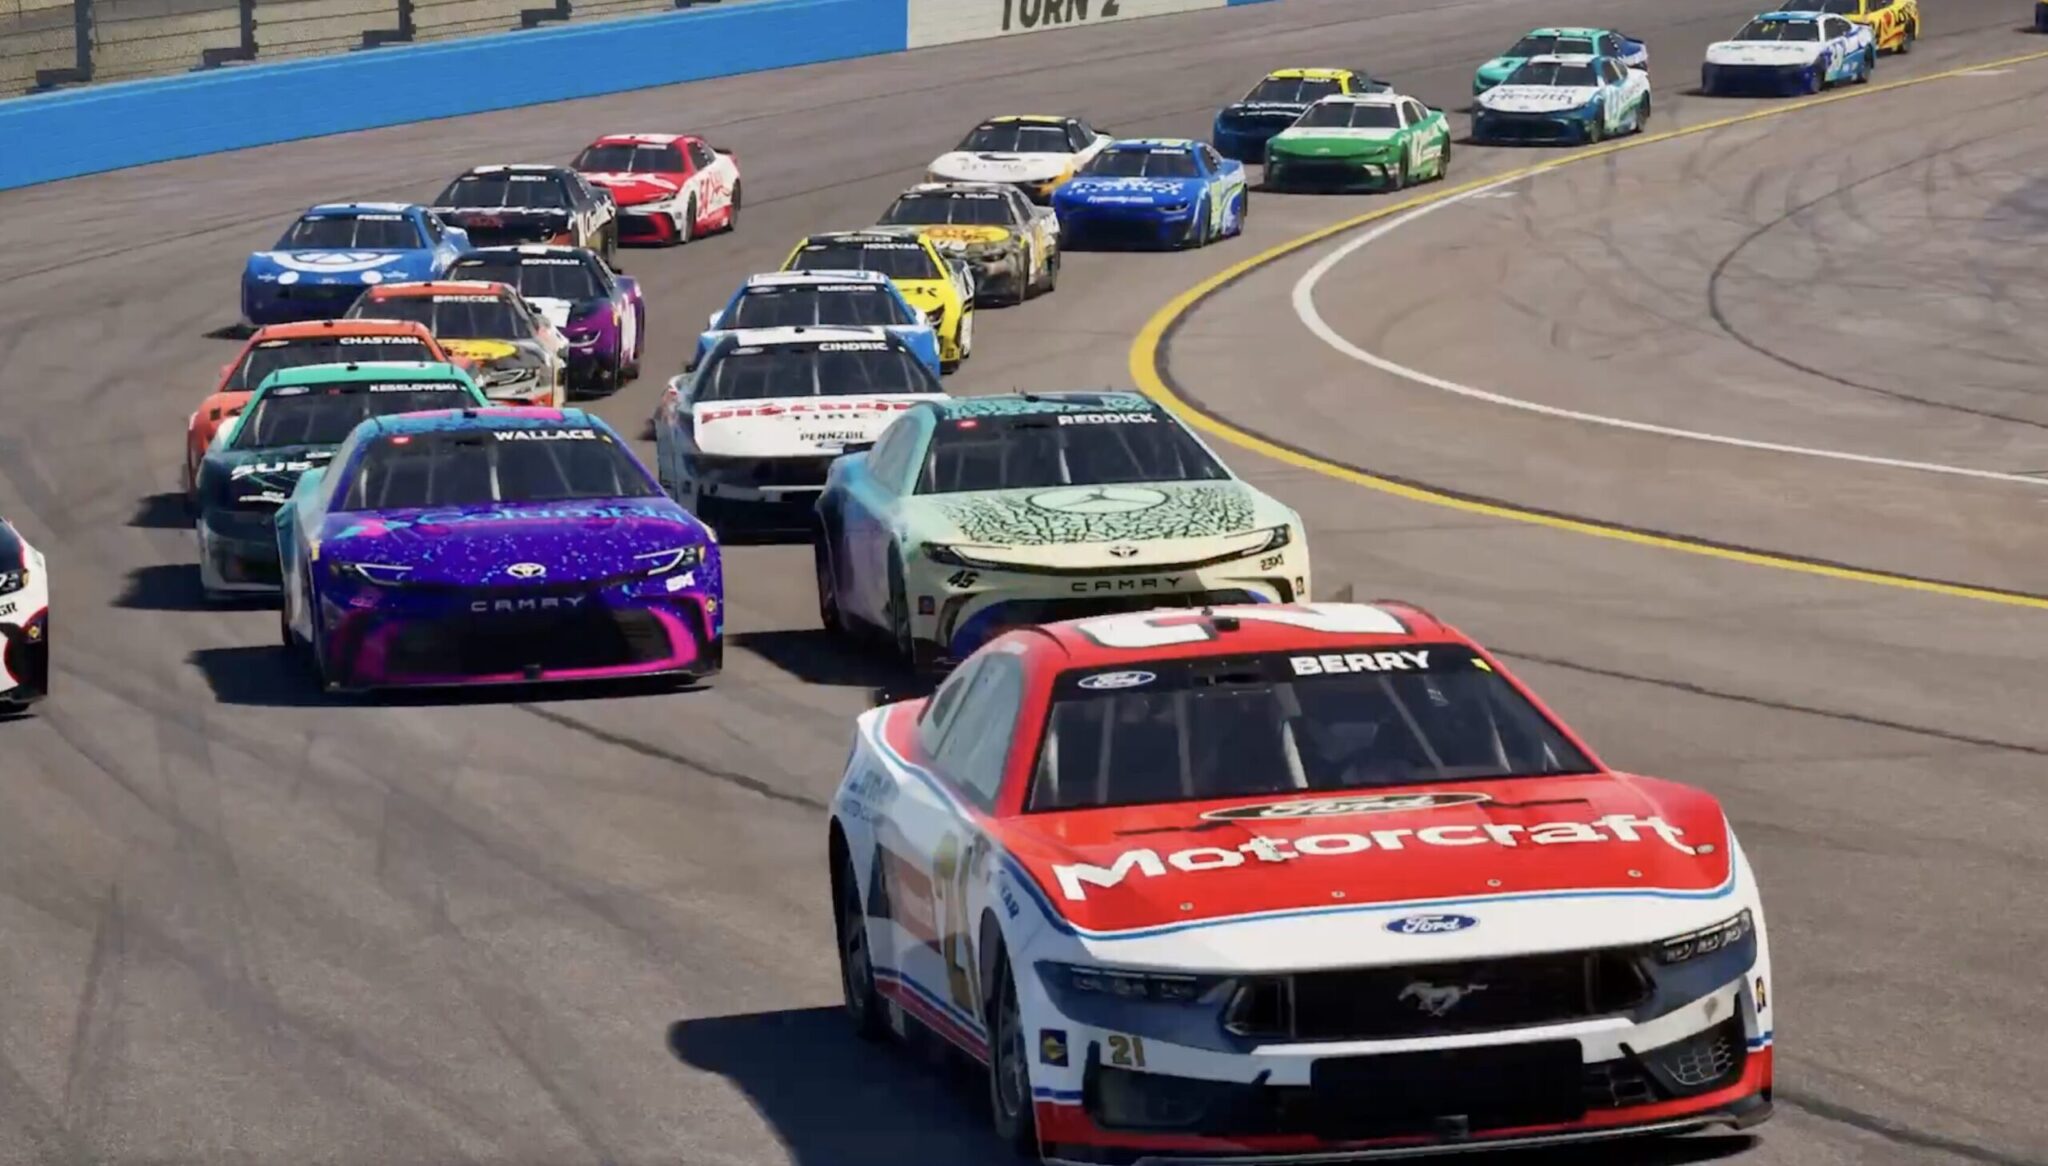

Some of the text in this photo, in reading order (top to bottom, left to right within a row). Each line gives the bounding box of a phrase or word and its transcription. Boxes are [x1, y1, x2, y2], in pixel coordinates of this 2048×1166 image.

[521, 258, 580, 266] BOWMAN
[432, 294, 500, 304] BRISCOE
[339, 336, 420, 346] CHASTAIN
[818, 342, 889, 352] CINDRIC
[369, 383, 459, 393] KESELOWSKI
[1057, 413, 1158, 427] REDDICK
[493, 429, 597, 442] WALLACE
[799, 430, 867, 442] PENNZOIL
[947, 569, 980, 589] 45
[1071, 575, 1184, 593] CAMRY
[471, 595, 587, 614] CAMRY
[1290, 650, 1431, 676] BERRY
[1051, 813, 1697, 902] Motorcraft
[1402, 915, 1461, 933] Ford
[1107, 1034, 1146, 1068] 21
